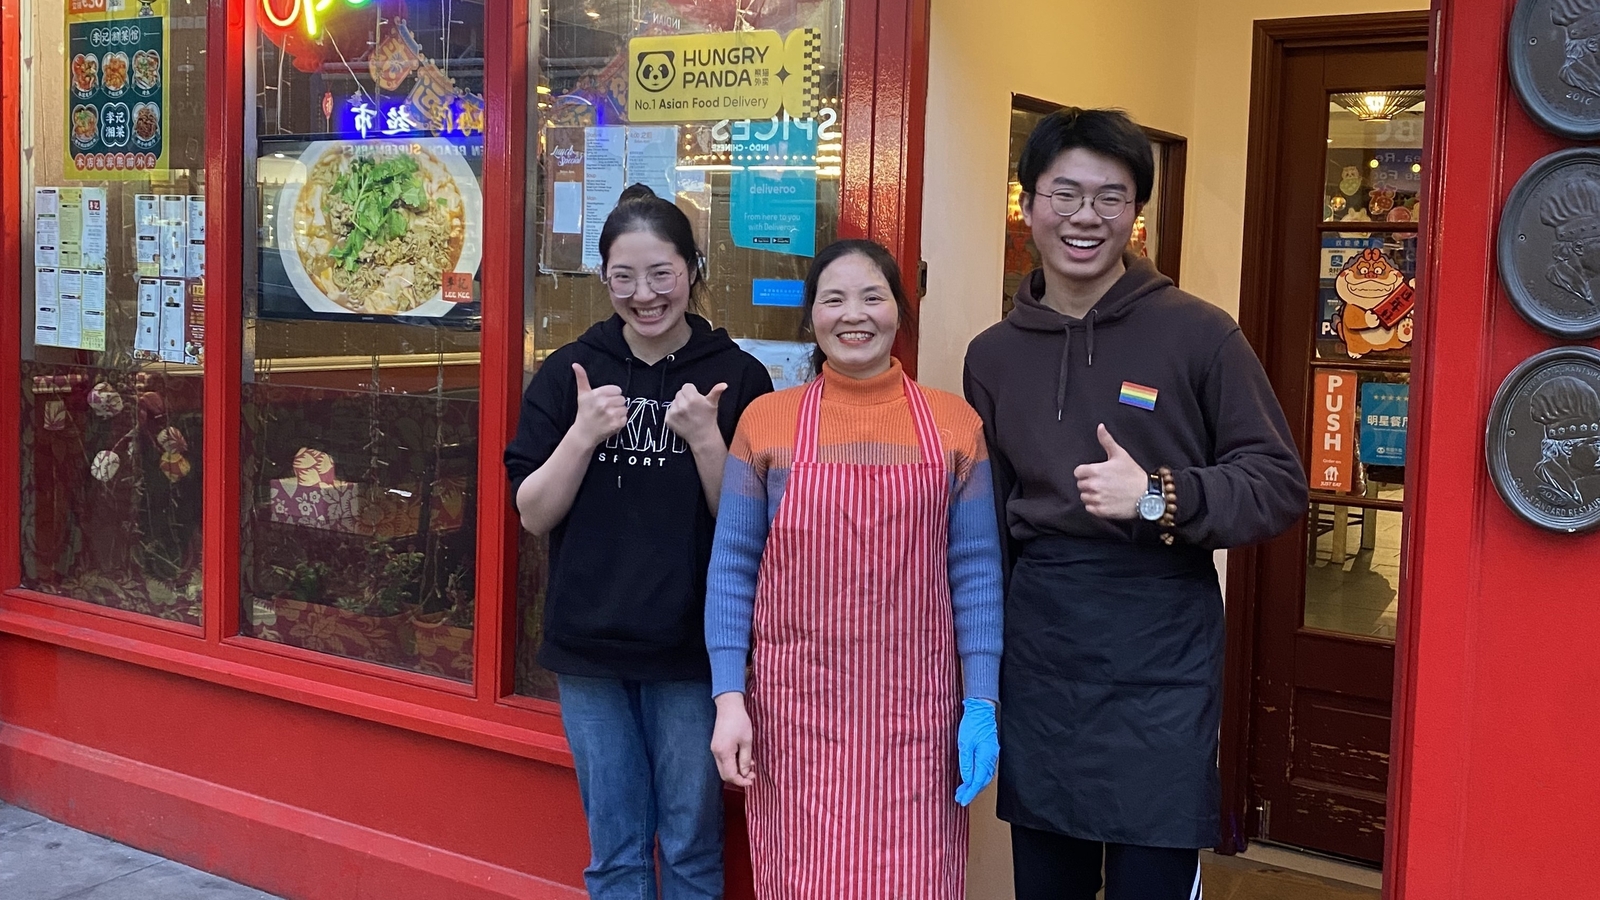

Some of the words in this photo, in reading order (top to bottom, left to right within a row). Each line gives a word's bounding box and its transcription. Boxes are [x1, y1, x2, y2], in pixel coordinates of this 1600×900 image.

[683, 46, 769, 67] HUNGRY
[683, 69, 752, 89] PANDA
[635, 99, 656, 110] No.1
[659, 98, 689, 110] Asian
[692, 97, 720, 108] Food
[723, 96, 769, 109] Delivery
[749, 183, 796, 194] deliveroo
[744, 212, 761, 221] From
[762, 212, 778, 221] here
[779, 213, 787, 221] to
[787, 214, 801, 223] you
[1323, 375, 1343, 452] PUSH
